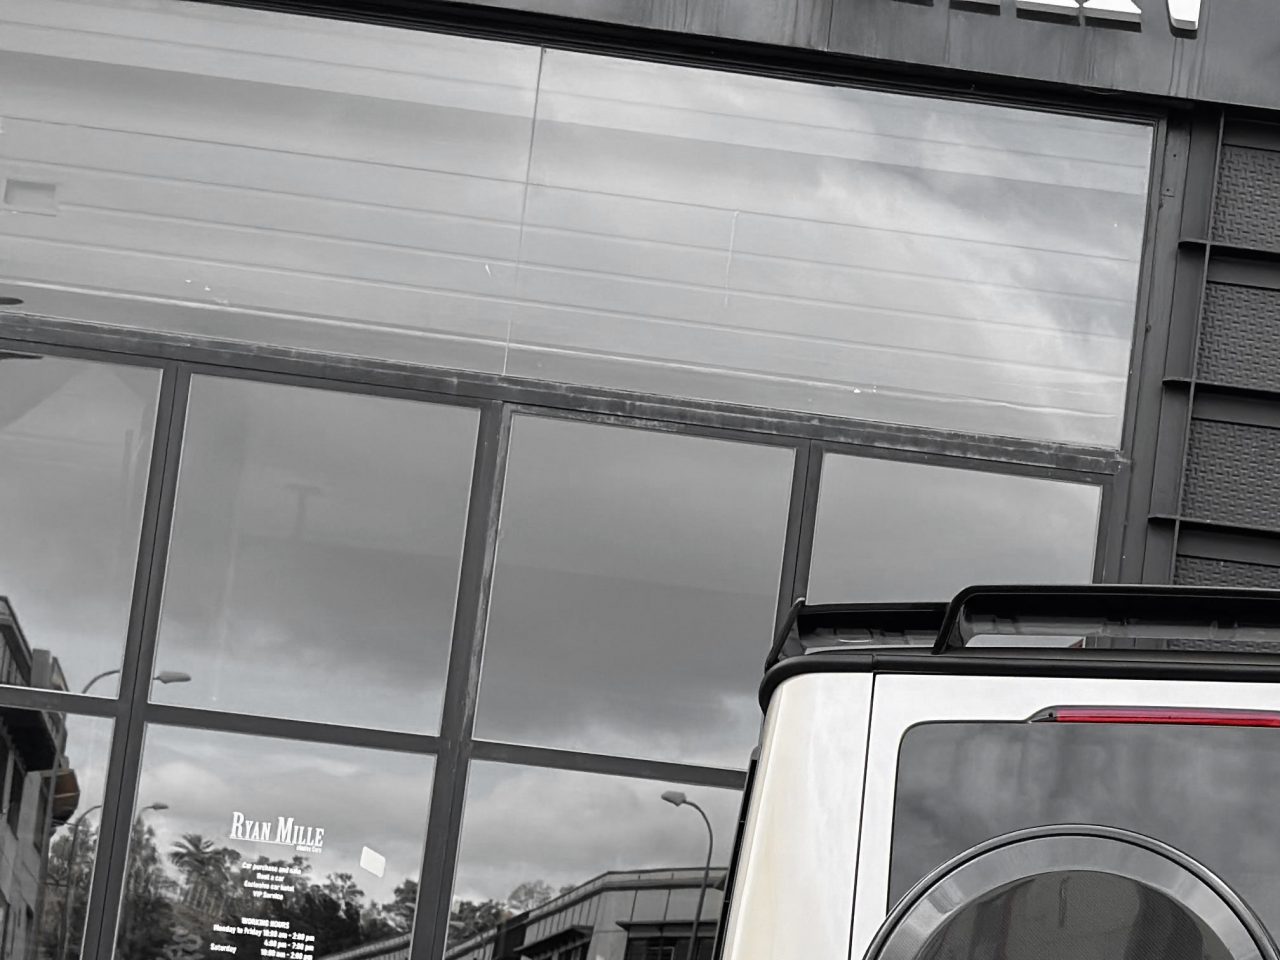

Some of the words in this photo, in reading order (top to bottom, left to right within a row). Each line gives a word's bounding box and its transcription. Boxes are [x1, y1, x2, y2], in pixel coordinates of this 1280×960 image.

[230, 811, 271, 841] RYAN
[276, 816, 324, 846] MILLE
[252, 864, 278, 872] purchase
[279, 865, 289, 873] and
[263, 892, 284, 900] Service
[242, 917, 269, 927] WORKING
[270, 920, 290, 929] HOURS
[213, 924, 236, 934] Monday
[244, 927, 262, 937] Friday
[210, 943, 237, 954] Saturday
